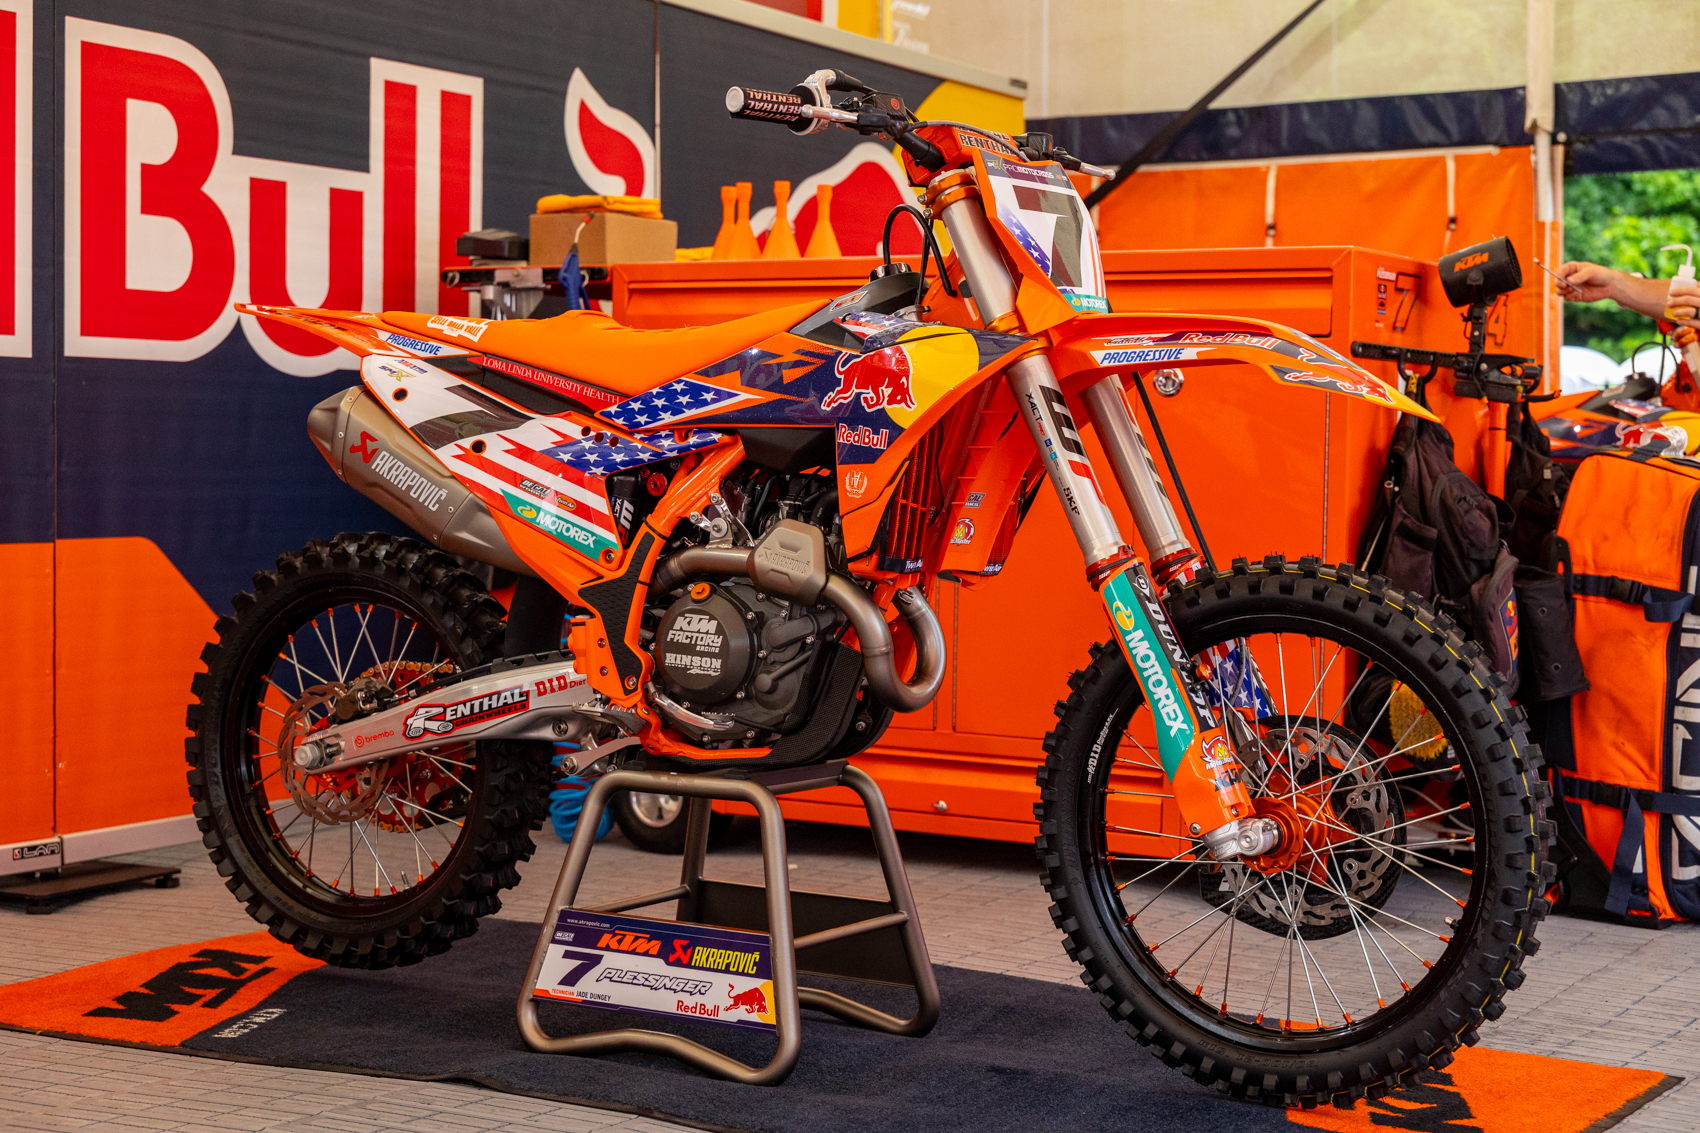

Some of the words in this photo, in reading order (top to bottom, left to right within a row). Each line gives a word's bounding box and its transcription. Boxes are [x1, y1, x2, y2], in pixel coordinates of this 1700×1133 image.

[746, 90, 801, 104] RENTHAL
[747, 100, 802, 115] RENTHAL
[958, 133, 1017, 156] RENTHA
[64, 15, 484, 377] Bull
[1012, 184, 1084, 288] 7
[1454, 252, 1489, 273] KTM
[385, 333, 443, 356] PROGRESSIVE
[1178, 332, 1232, 346] Red
[1230, 334, 1281, 350] Bull
[1100, 348, 1185, 365] PROGRESSIVE
[482, 357, 506, 371] LOMA
[507, 363, 532, 379] LINDA
[533, 371, 582, 394] UNIVERSITY
[582, 387, 619, 404] HEALTH
[837, 423, 863, 446] Red
[861, 427, 889, 450] Bull
[371, 450, 449, 512] AKRAPOVIČ
[1063, 487, 1080, 516] SKF
[536, 511, 597, 548] MOTOREX
[672, 613, 718, 634] KTM
[666, 629, 723, 647] FACTORY
[665, 652, 722, 669] HINSON
[1125, 629, 1188, 738] MOTOREX
[455, 702, 527, 727] CHAINWHEELS
[365, 730, 395, 743] brembo
[596, 930, 661, 955] KTM
[556, 950, 604, 988] 7
[691, 946, 760, 975] AKRAPOVIČ
[596, 967, 713, 996] PLESSINGER
[551, 988, 575, 996] TECHNICIAN
[575, 990, 589, 999] JADE
[589, 991, 611, 1002] DUNGEY
[676, 1000, 698, 1015] Red
[699, 1002, 720, 1018] Bull
